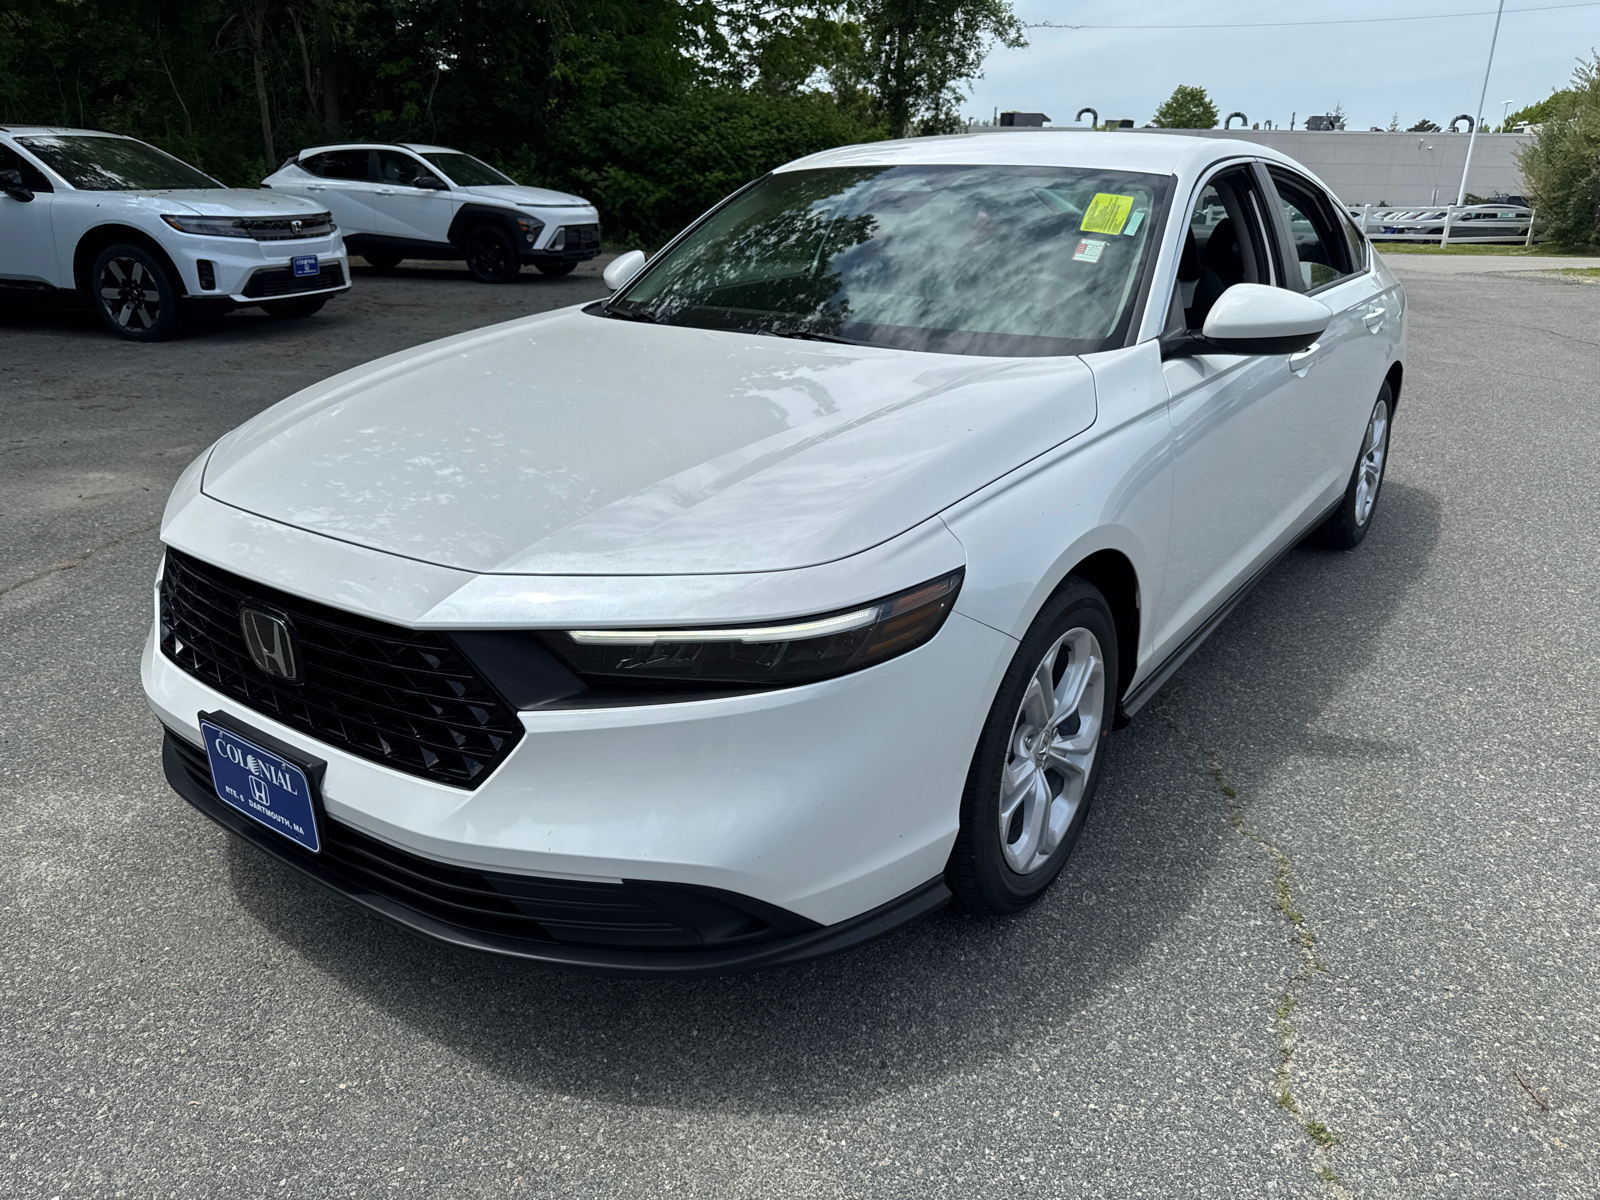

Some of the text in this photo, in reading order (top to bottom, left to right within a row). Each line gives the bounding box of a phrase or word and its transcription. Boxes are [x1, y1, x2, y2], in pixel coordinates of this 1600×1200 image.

[215, 738, 298, 796] COLONIAL
[225, 785, 240, 799] RTE.
[248, 799, 293, 830] DARTMOUTH,
[293, 822, 305, 836] MA
